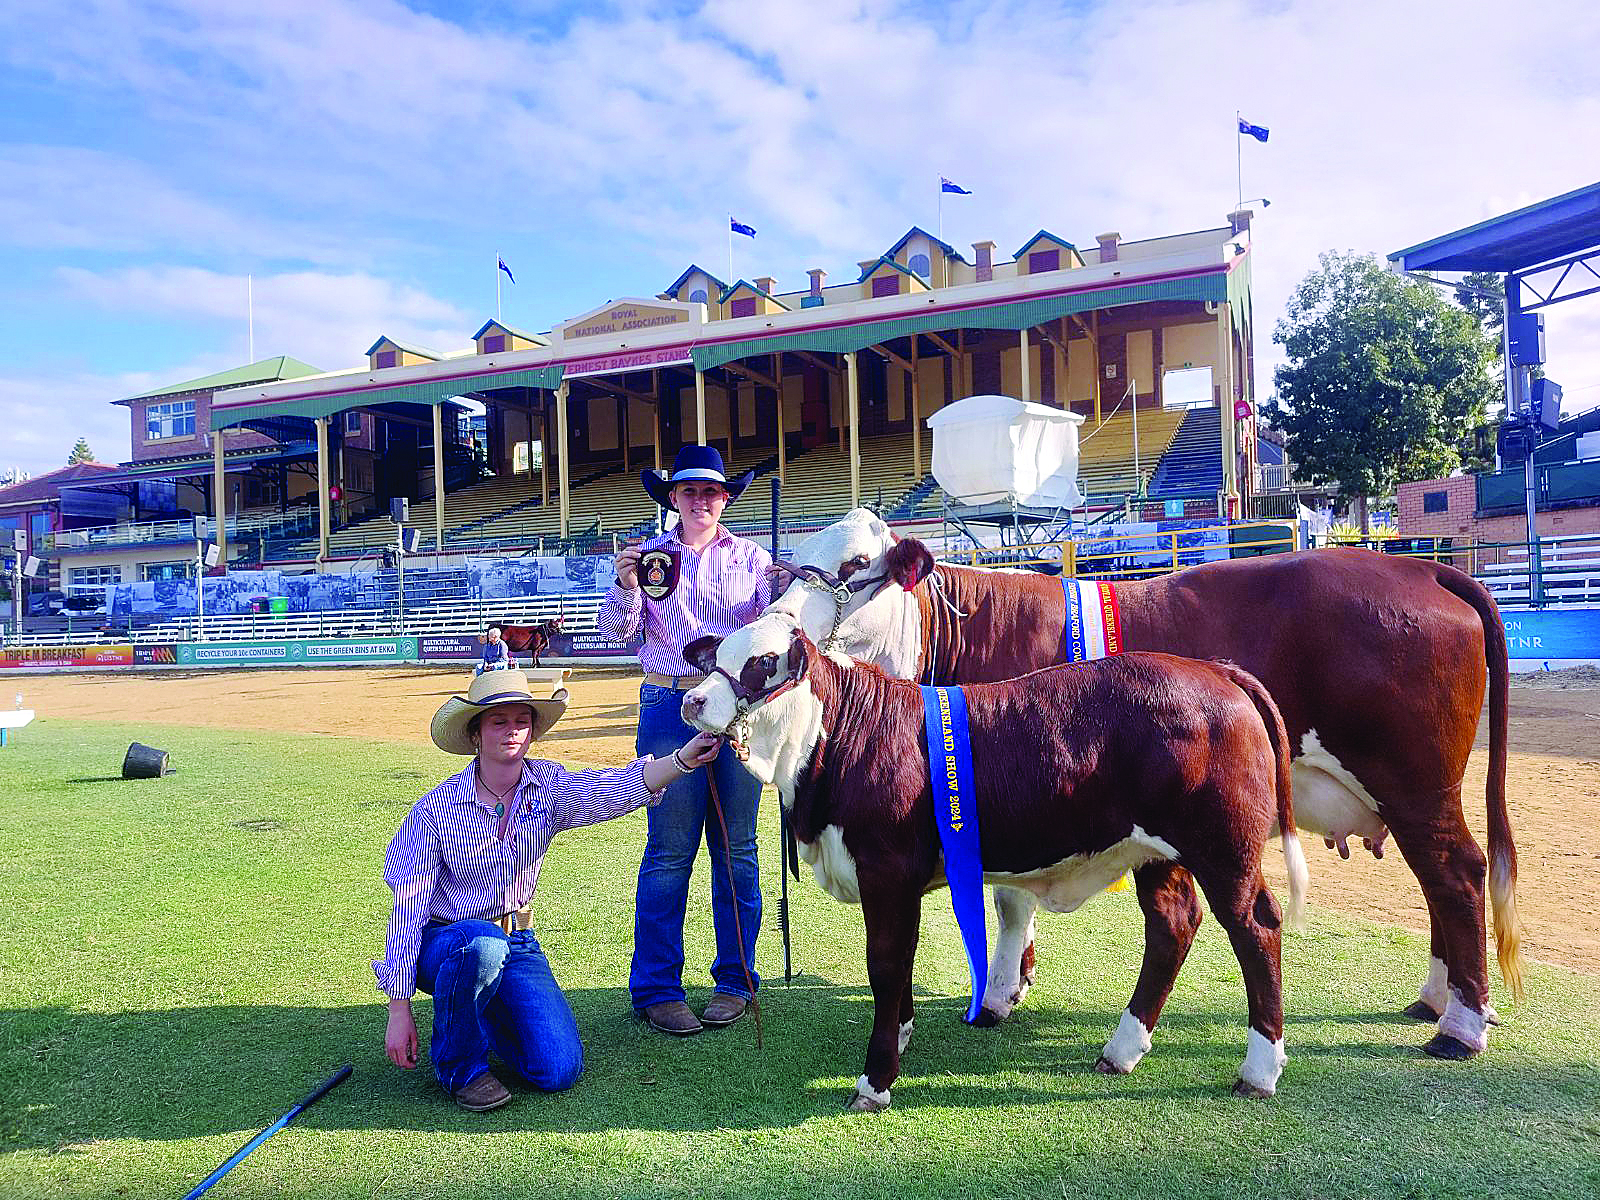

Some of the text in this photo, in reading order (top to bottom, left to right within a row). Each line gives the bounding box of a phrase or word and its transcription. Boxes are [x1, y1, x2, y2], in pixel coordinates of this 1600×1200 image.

[611, 309, 638, 320] ROYAL
[575, 315, 677, 337] NATIONAL ASSOCIATION
[568, 360, 608, 375] ERNEST
[656, 348, 690, 363] STAND
[1104, 604, 1118, 653] QUEENSLAND
[572, 635, 608, 643] MULTICULTU
[1506, 637, 1544, 648] TNR
[5, 647, 87, 661] TRIPLE M BREAKFAST
[196, 650, 220, 658] RECYCLE
[221, 649, 238, 657] YOUR
[249, 648, 285, 656] CONTAINERS
[307, 645, 395, 655] USE THE GREEN BINS AT EKKA
[945, 755, 959, 791] SHOW
[949, 795, 962, 821] 2024
